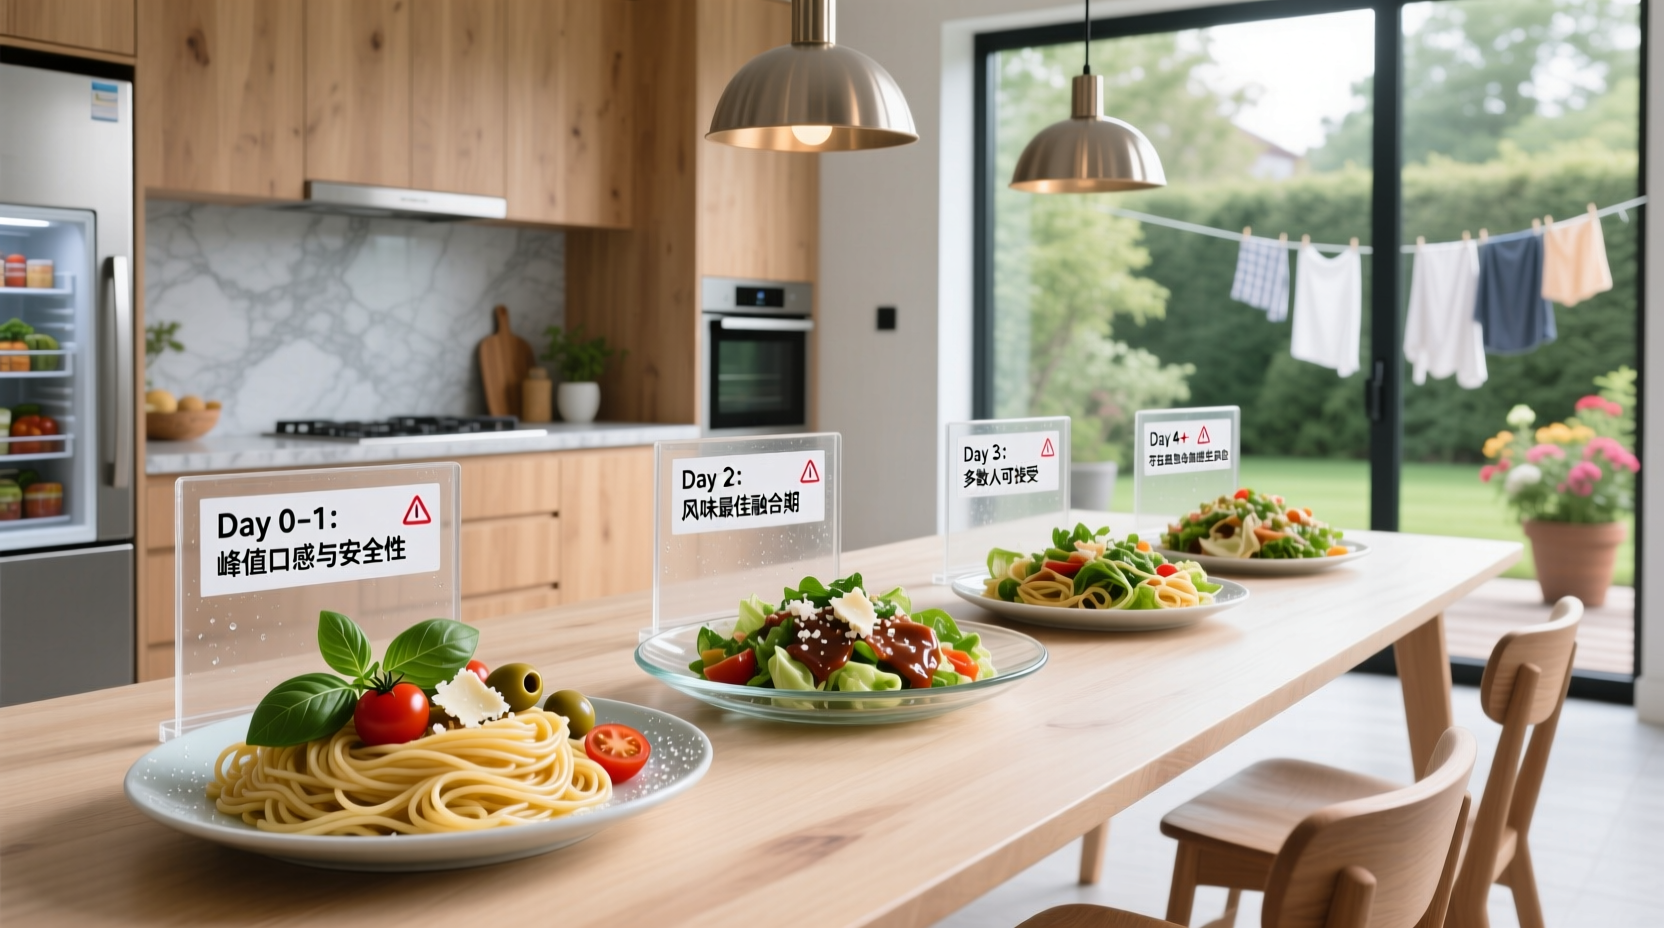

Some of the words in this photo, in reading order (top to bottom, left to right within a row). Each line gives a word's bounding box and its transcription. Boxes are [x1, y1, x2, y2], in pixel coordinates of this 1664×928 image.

[1150, 431, 1171, 448] Day
[963, 446, 989, 465] Day
[992, 444, 1007, 461] 3:
[682, 469, 717, 493] Day
[723, 466, 742, 488] 2:
[681, 489, 800, 521] 风味最佳融合期
[217, 512, 272, 542] Day
[217, 535, 407, 577] 峰值口感与安全性
